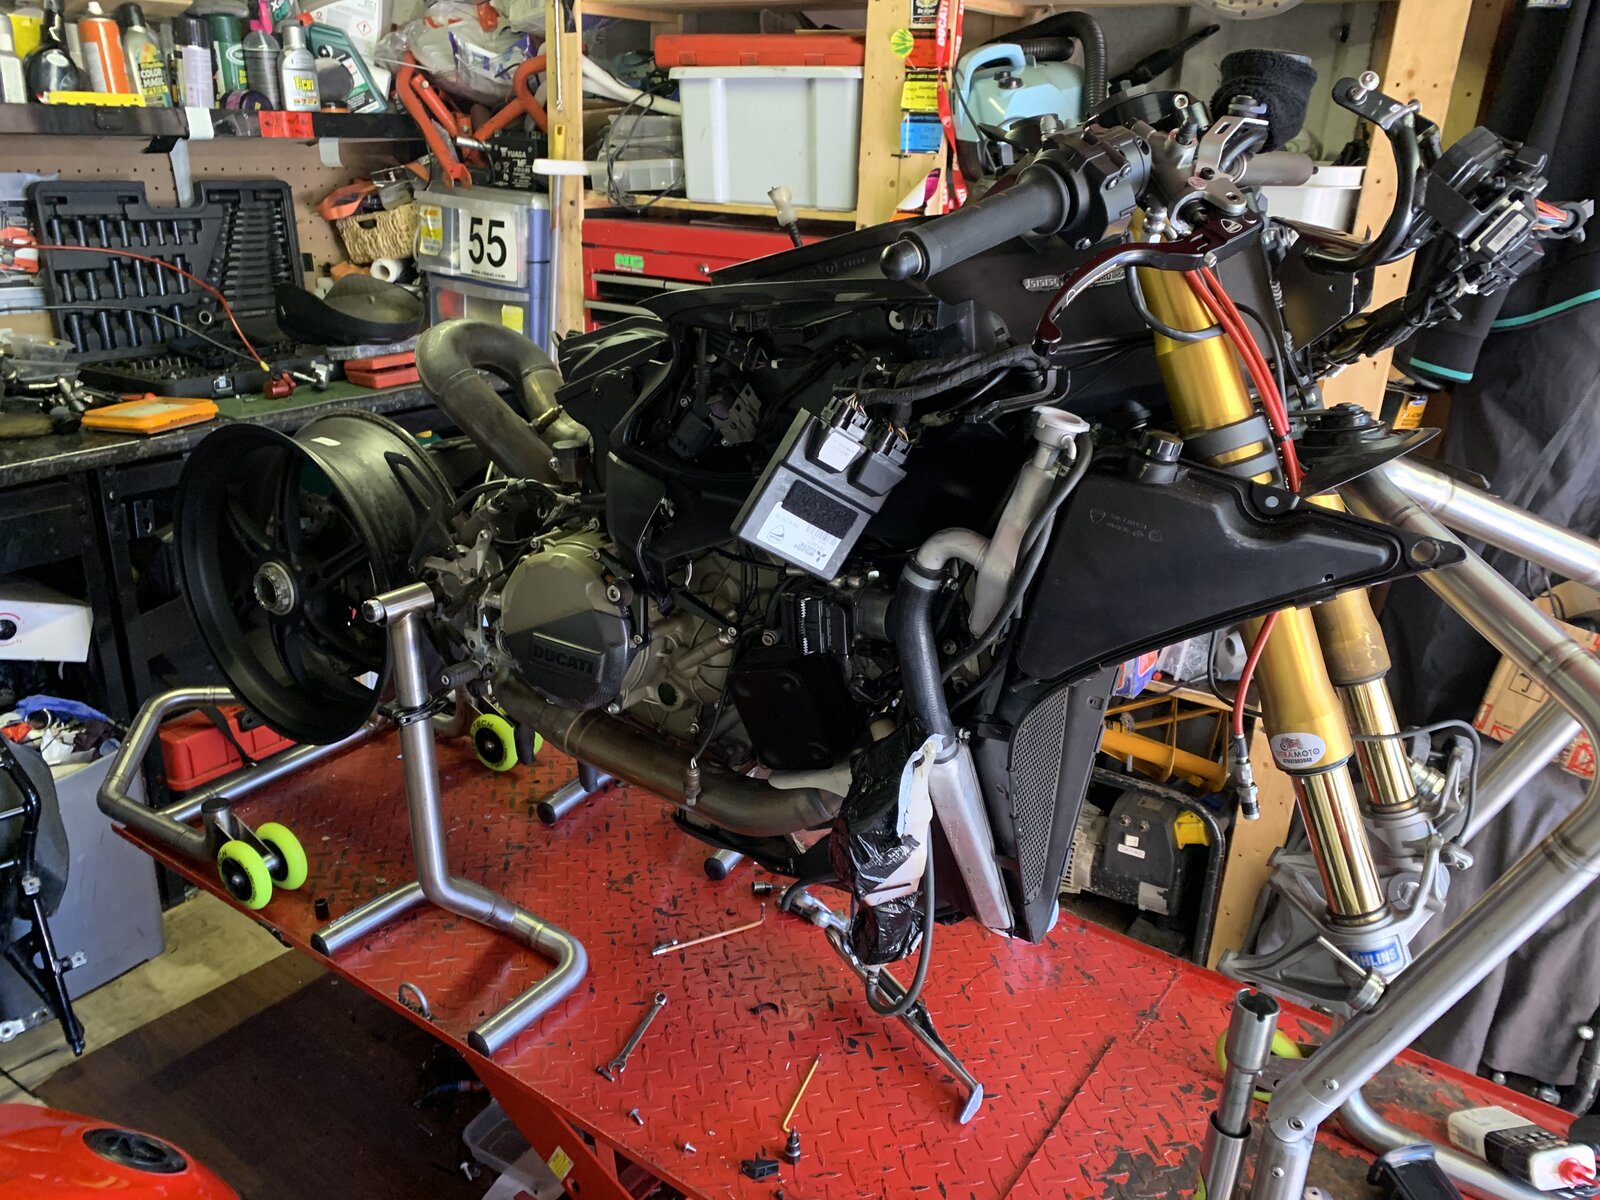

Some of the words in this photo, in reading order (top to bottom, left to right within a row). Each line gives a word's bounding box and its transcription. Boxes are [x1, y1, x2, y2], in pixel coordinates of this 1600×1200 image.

[937, 0, 950, 47] DUCATI
[507, 150, 527, 158] YUASA
[468, 216, 507, 268] 55
[533, 643, 593, 674] DUCATI
